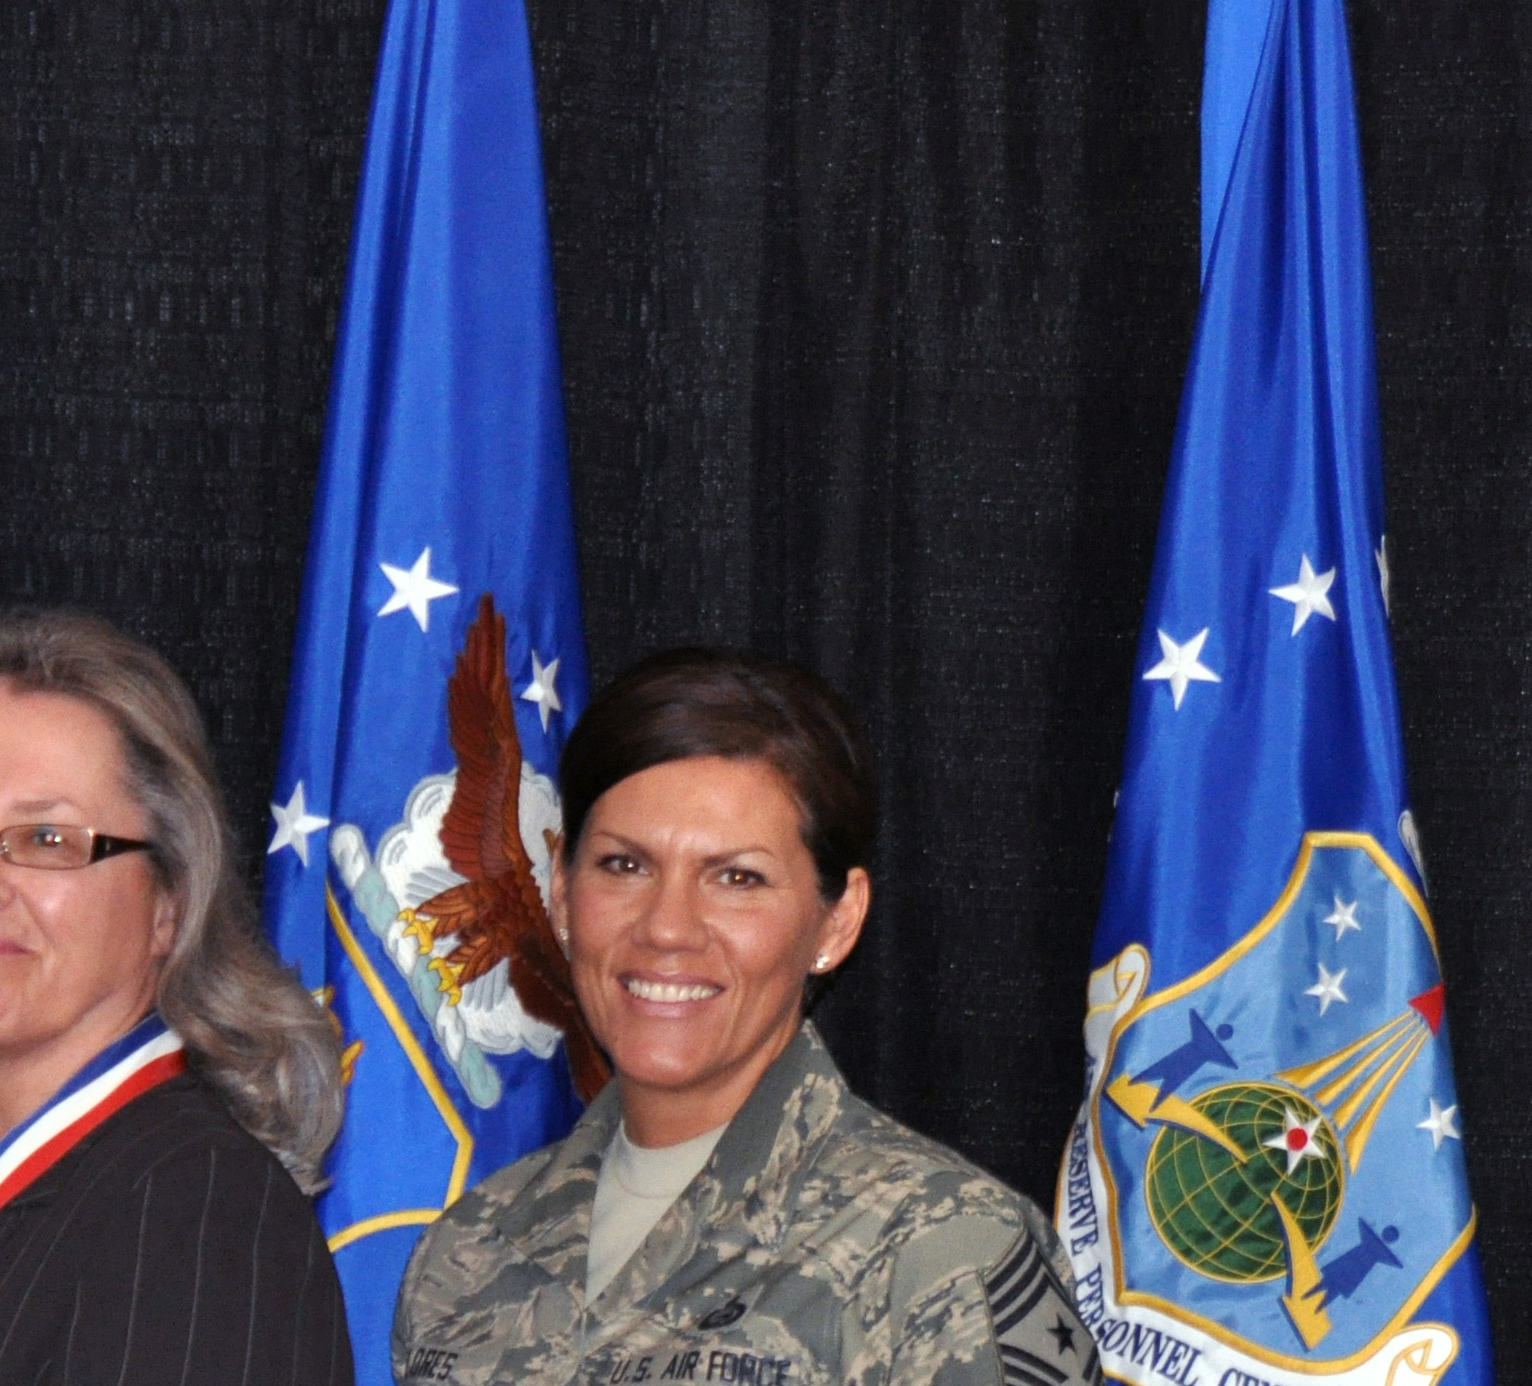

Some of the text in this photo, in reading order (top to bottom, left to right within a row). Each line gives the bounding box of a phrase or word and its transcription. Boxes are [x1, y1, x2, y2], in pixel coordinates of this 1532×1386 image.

[1068, 1122, 1099, 1256] RESERVE
[610, 1357, 654, 1385] U.S.
[660, 1350, 700, 1380] AIR
